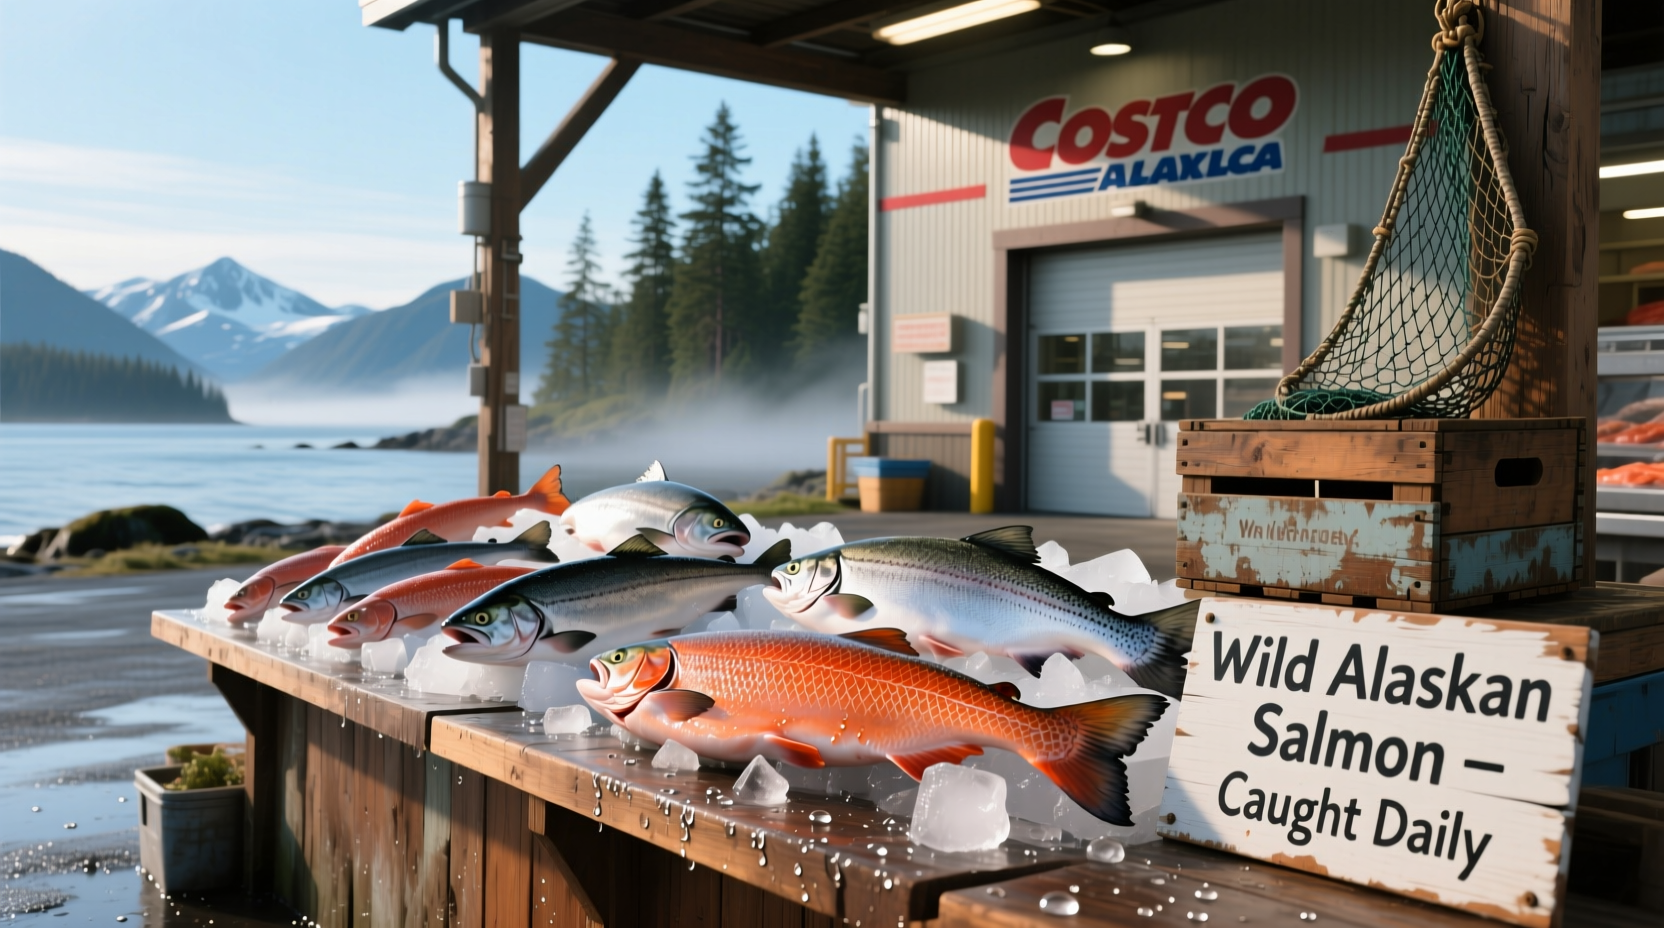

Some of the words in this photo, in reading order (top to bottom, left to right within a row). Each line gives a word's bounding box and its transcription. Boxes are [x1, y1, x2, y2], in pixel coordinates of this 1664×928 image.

[1009, 75, 1297, 171] COSTCO
[1213, 630, 1319, 693] Wild
[1326, 643, 1552, 723] Alaskan
[1247, 702, 1445, 786] Salmon
[1218, 770, 1362, 847] Caught
[1372, 798, 1493, 881] Daily
